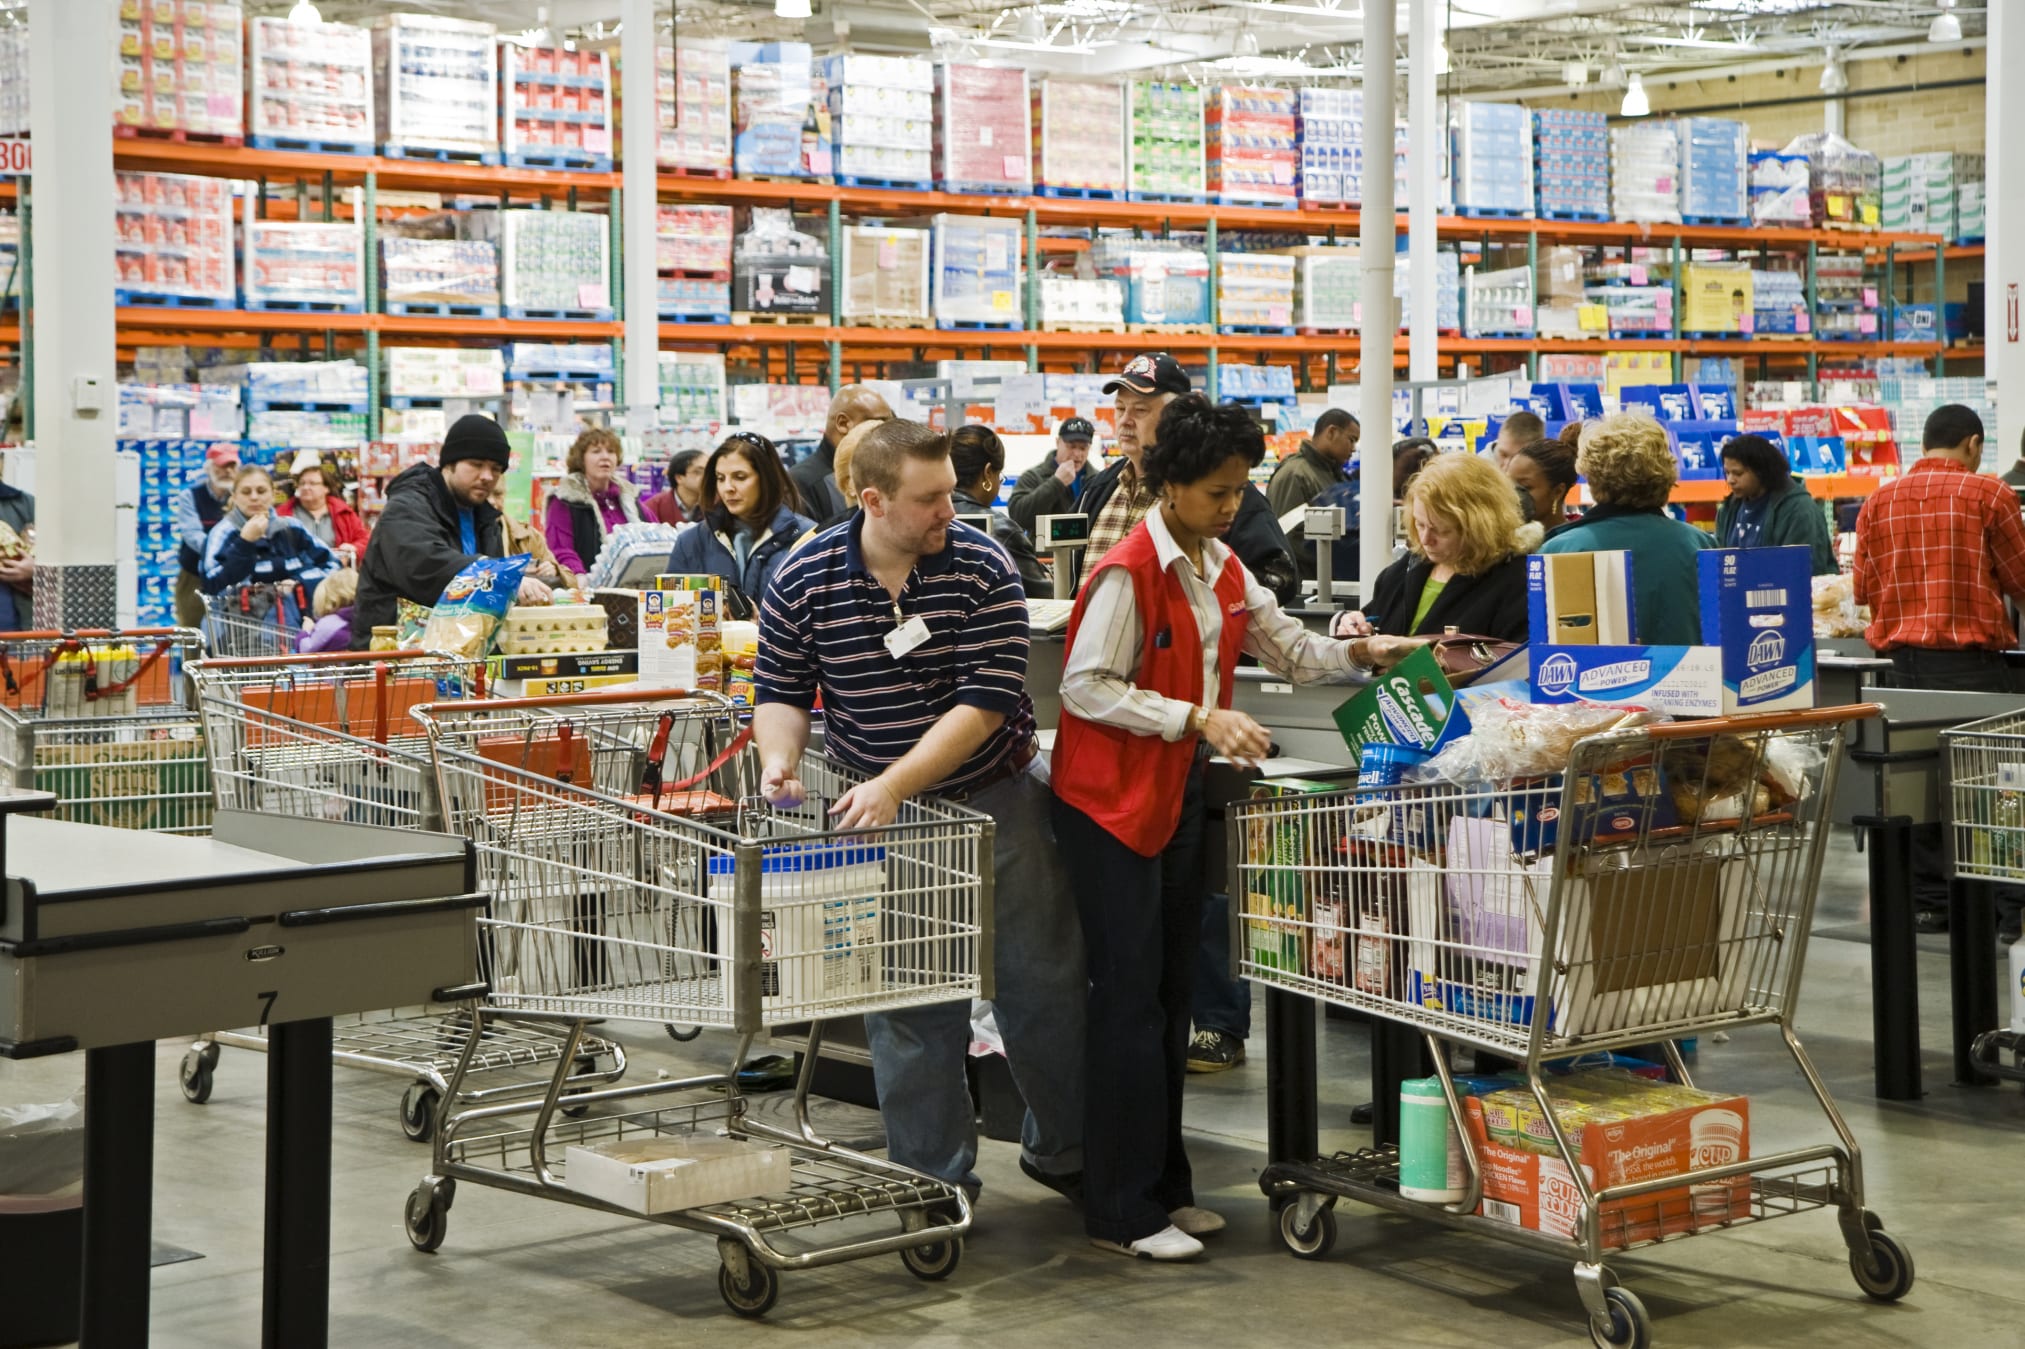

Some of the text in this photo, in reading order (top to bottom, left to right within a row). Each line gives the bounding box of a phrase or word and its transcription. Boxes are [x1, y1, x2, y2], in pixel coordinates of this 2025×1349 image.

[1748, 640, 1783, 665] DAWN
[1539, 662, 1575, 685] DAWN
[1581, 661, 1649, 682] ADVANCED
[1600, 676, 1628, 686] POWER
[1742, 667, 1795, 691] ADVANCED
[1651, 689, 1699, 698] INFUSED WITH
[1757, 682, 1780, 692] POWER
[1390, 676, 1436, 742] Cascade
[1684, 699, 1717, 708] ENZYMES
[257, 990, 279, 1025] 7
[1698, 1146, 1733, 1166] CUP
[1547, 1177, 1583, 1203] CUP
[1540, 1192, 1579, 1220] NOODL
